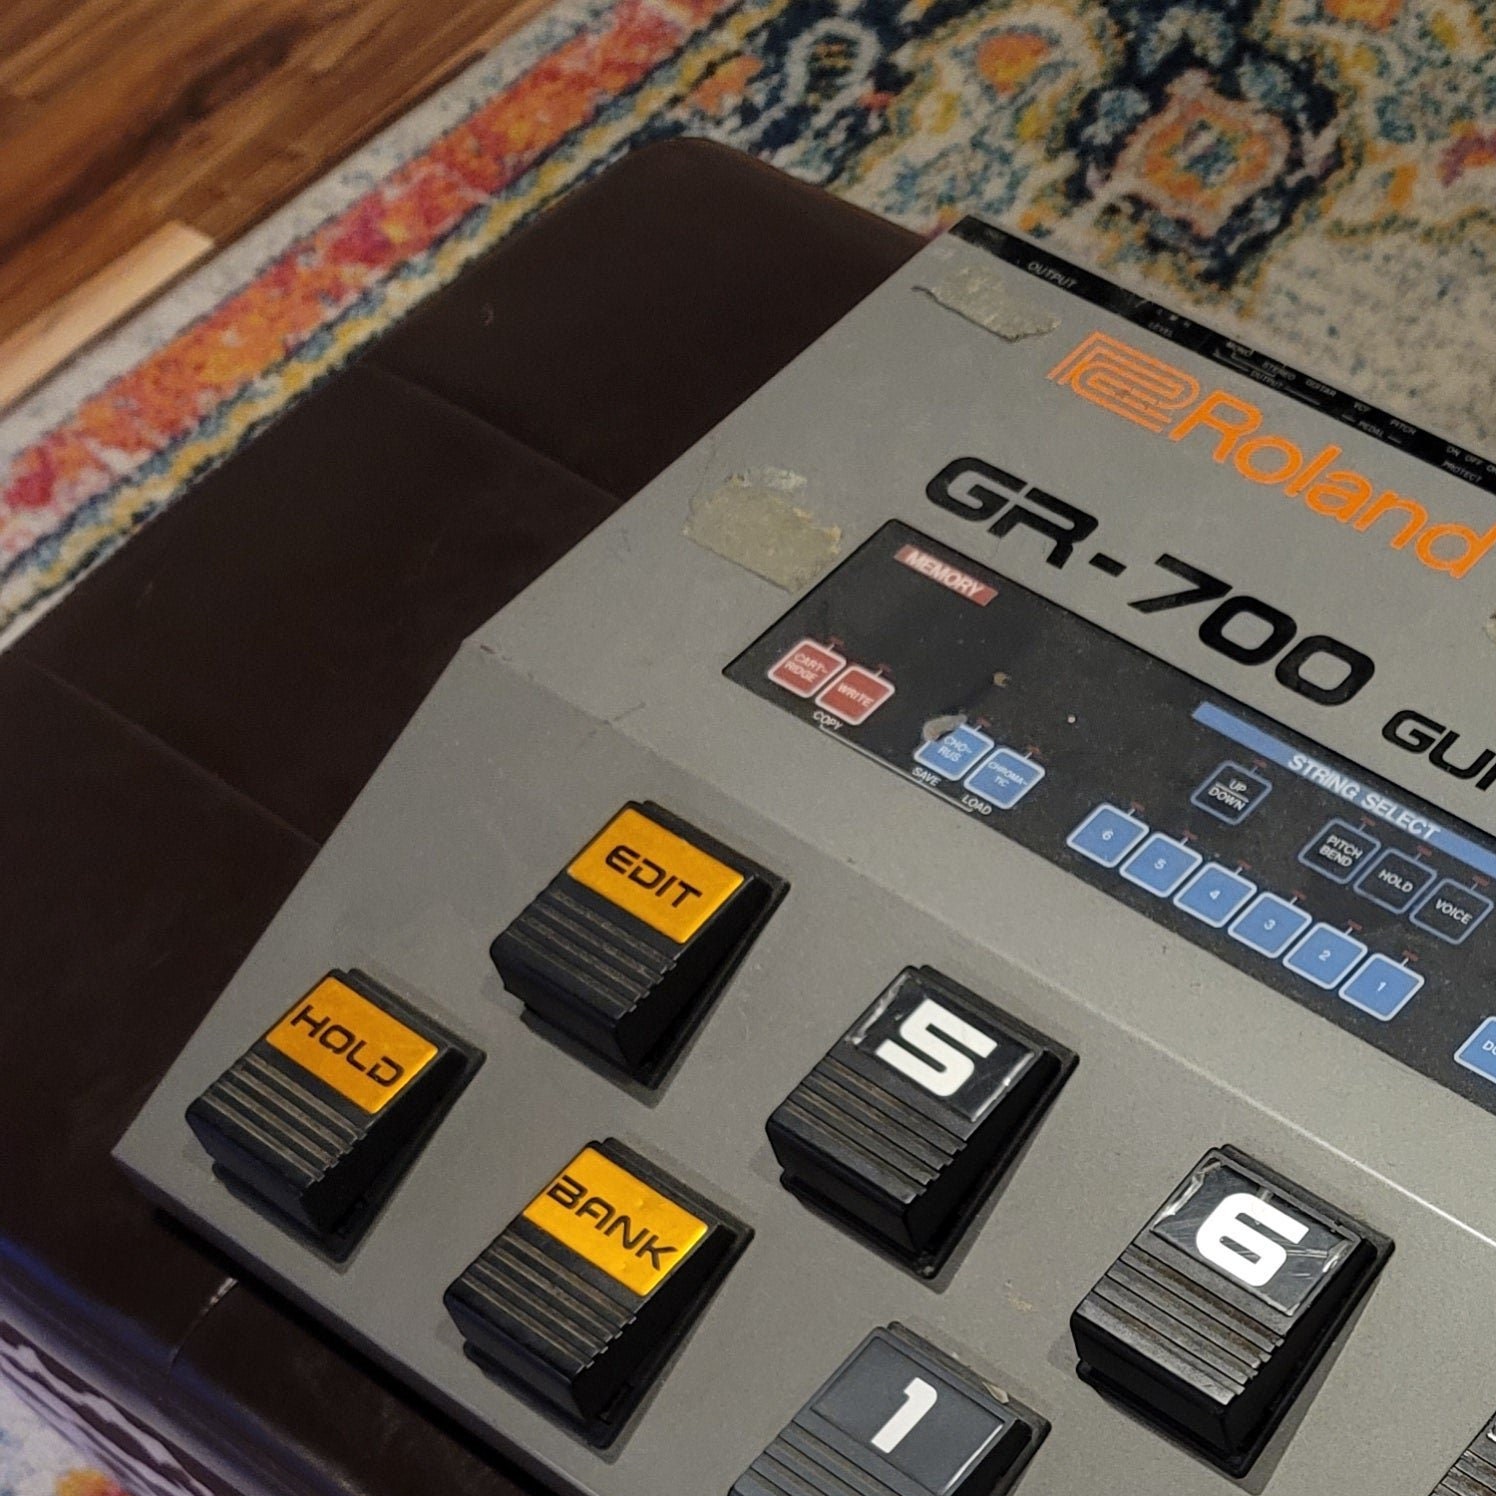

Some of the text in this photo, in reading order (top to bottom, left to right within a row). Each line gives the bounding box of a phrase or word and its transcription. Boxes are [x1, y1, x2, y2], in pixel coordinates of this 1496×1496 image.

[1028, 261, 1078, 289] OUTPUT
[1357, 421, 1385, 438] PEDAL
[1441, 460, 1483, 483] PROTECT
[904, 549, 986, 599] MEMORY
[925, 456, 1376, 706] GR-700
[782, 661, 818, 684] RIDGE
[836, 682, 875, 708] WRITE
[813, 710, 845, 731] COPY
[938, 745, 963, 763] RUS
[911, 766, 942, 788] SAVE
[1227, 779, 1248, 795] UP
[961, 794, 993, 816] LOAD
[1207, 785, 1247, 812] DOWN
[1288, 753, 1443, 841] STRING SELECT
[1101, 829, 1113, 842] 6
[1326, 834, 1364, 860] PITCH
[1154, 857, 1166, 871] 5
[1318, 844, 1354, 869] BEND
[605, 845, 702, 909] EDIT
[1378, 868, 1415, 894] HOLD
[1209, 888, 1221, 902] 4
[1434, 898, 1473, 926] VOICE
[1264, 918, 1276, 932] 3
[1318, 948, 1331, 962] 2
[1376, 980, 1388, 993] 1
[290, 1004, 405, 1088] HOLD
[874, 998, 998, 1097] 5
[546, 1174, 679, 1272] BANK
[1195, 1192, 1310, 1287] 6
[870, 1375, 938, 1454] 1
